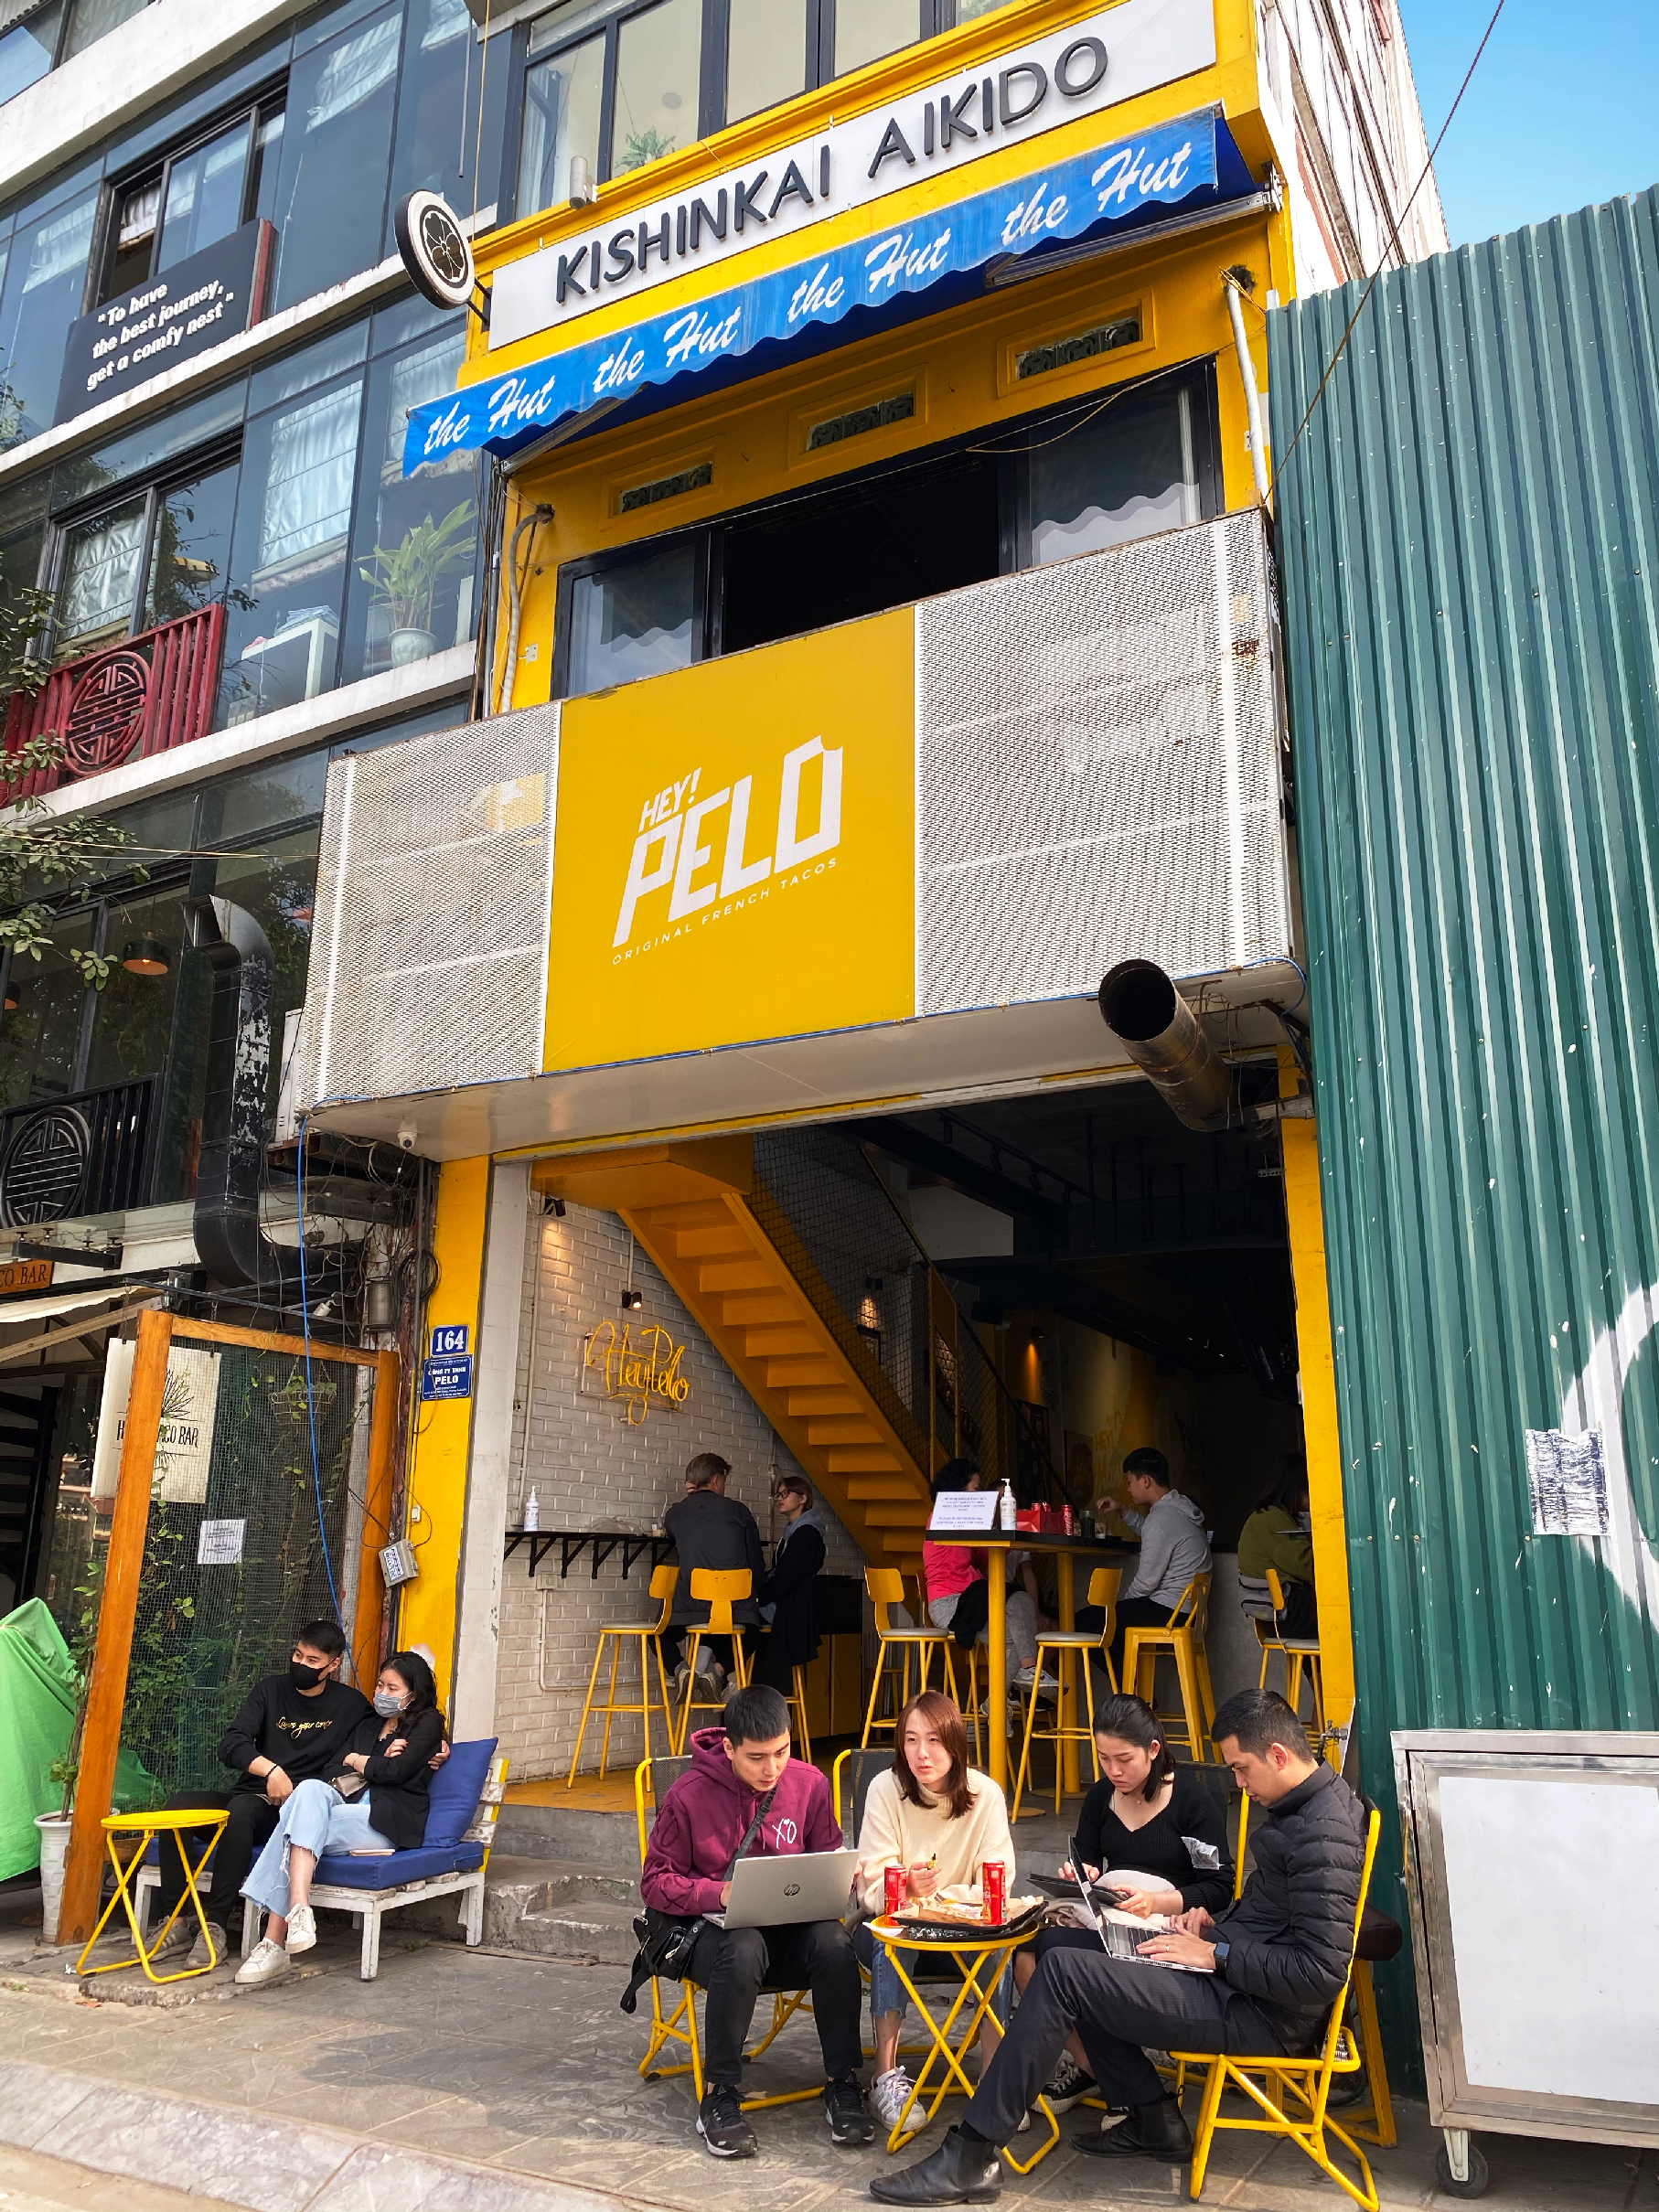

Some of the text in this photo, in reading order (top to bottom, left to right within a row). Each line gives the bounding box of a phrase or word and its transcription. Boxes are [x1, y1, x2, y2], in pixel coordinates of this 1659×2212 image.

[556, 37, 1108, 304] KISHINKAI AIKIDO
[128, 283, 168, 315] have
[423, 142, 1192, 455] the Hut the Hut the Hut the Hut
[87, 360, 115, 391] get
[116, 355, 129, 371] a
[132, 326, 184, 363] comfy
[92, 336, 118, 359] the
[120, 313, 156, 345] best
[638, 766, 702, 833] HEY!
[612, 734, 843, 948] PELO
[612, 857, 837, 965] ORIGINAL FRENCH TACOS
[20, 1264, 47, 1285] BAR
[435, 1329, 465, 1352] 164
[434, 1374, 459, 1385] PELO
[178, 1425, 199, 1448] BAR
